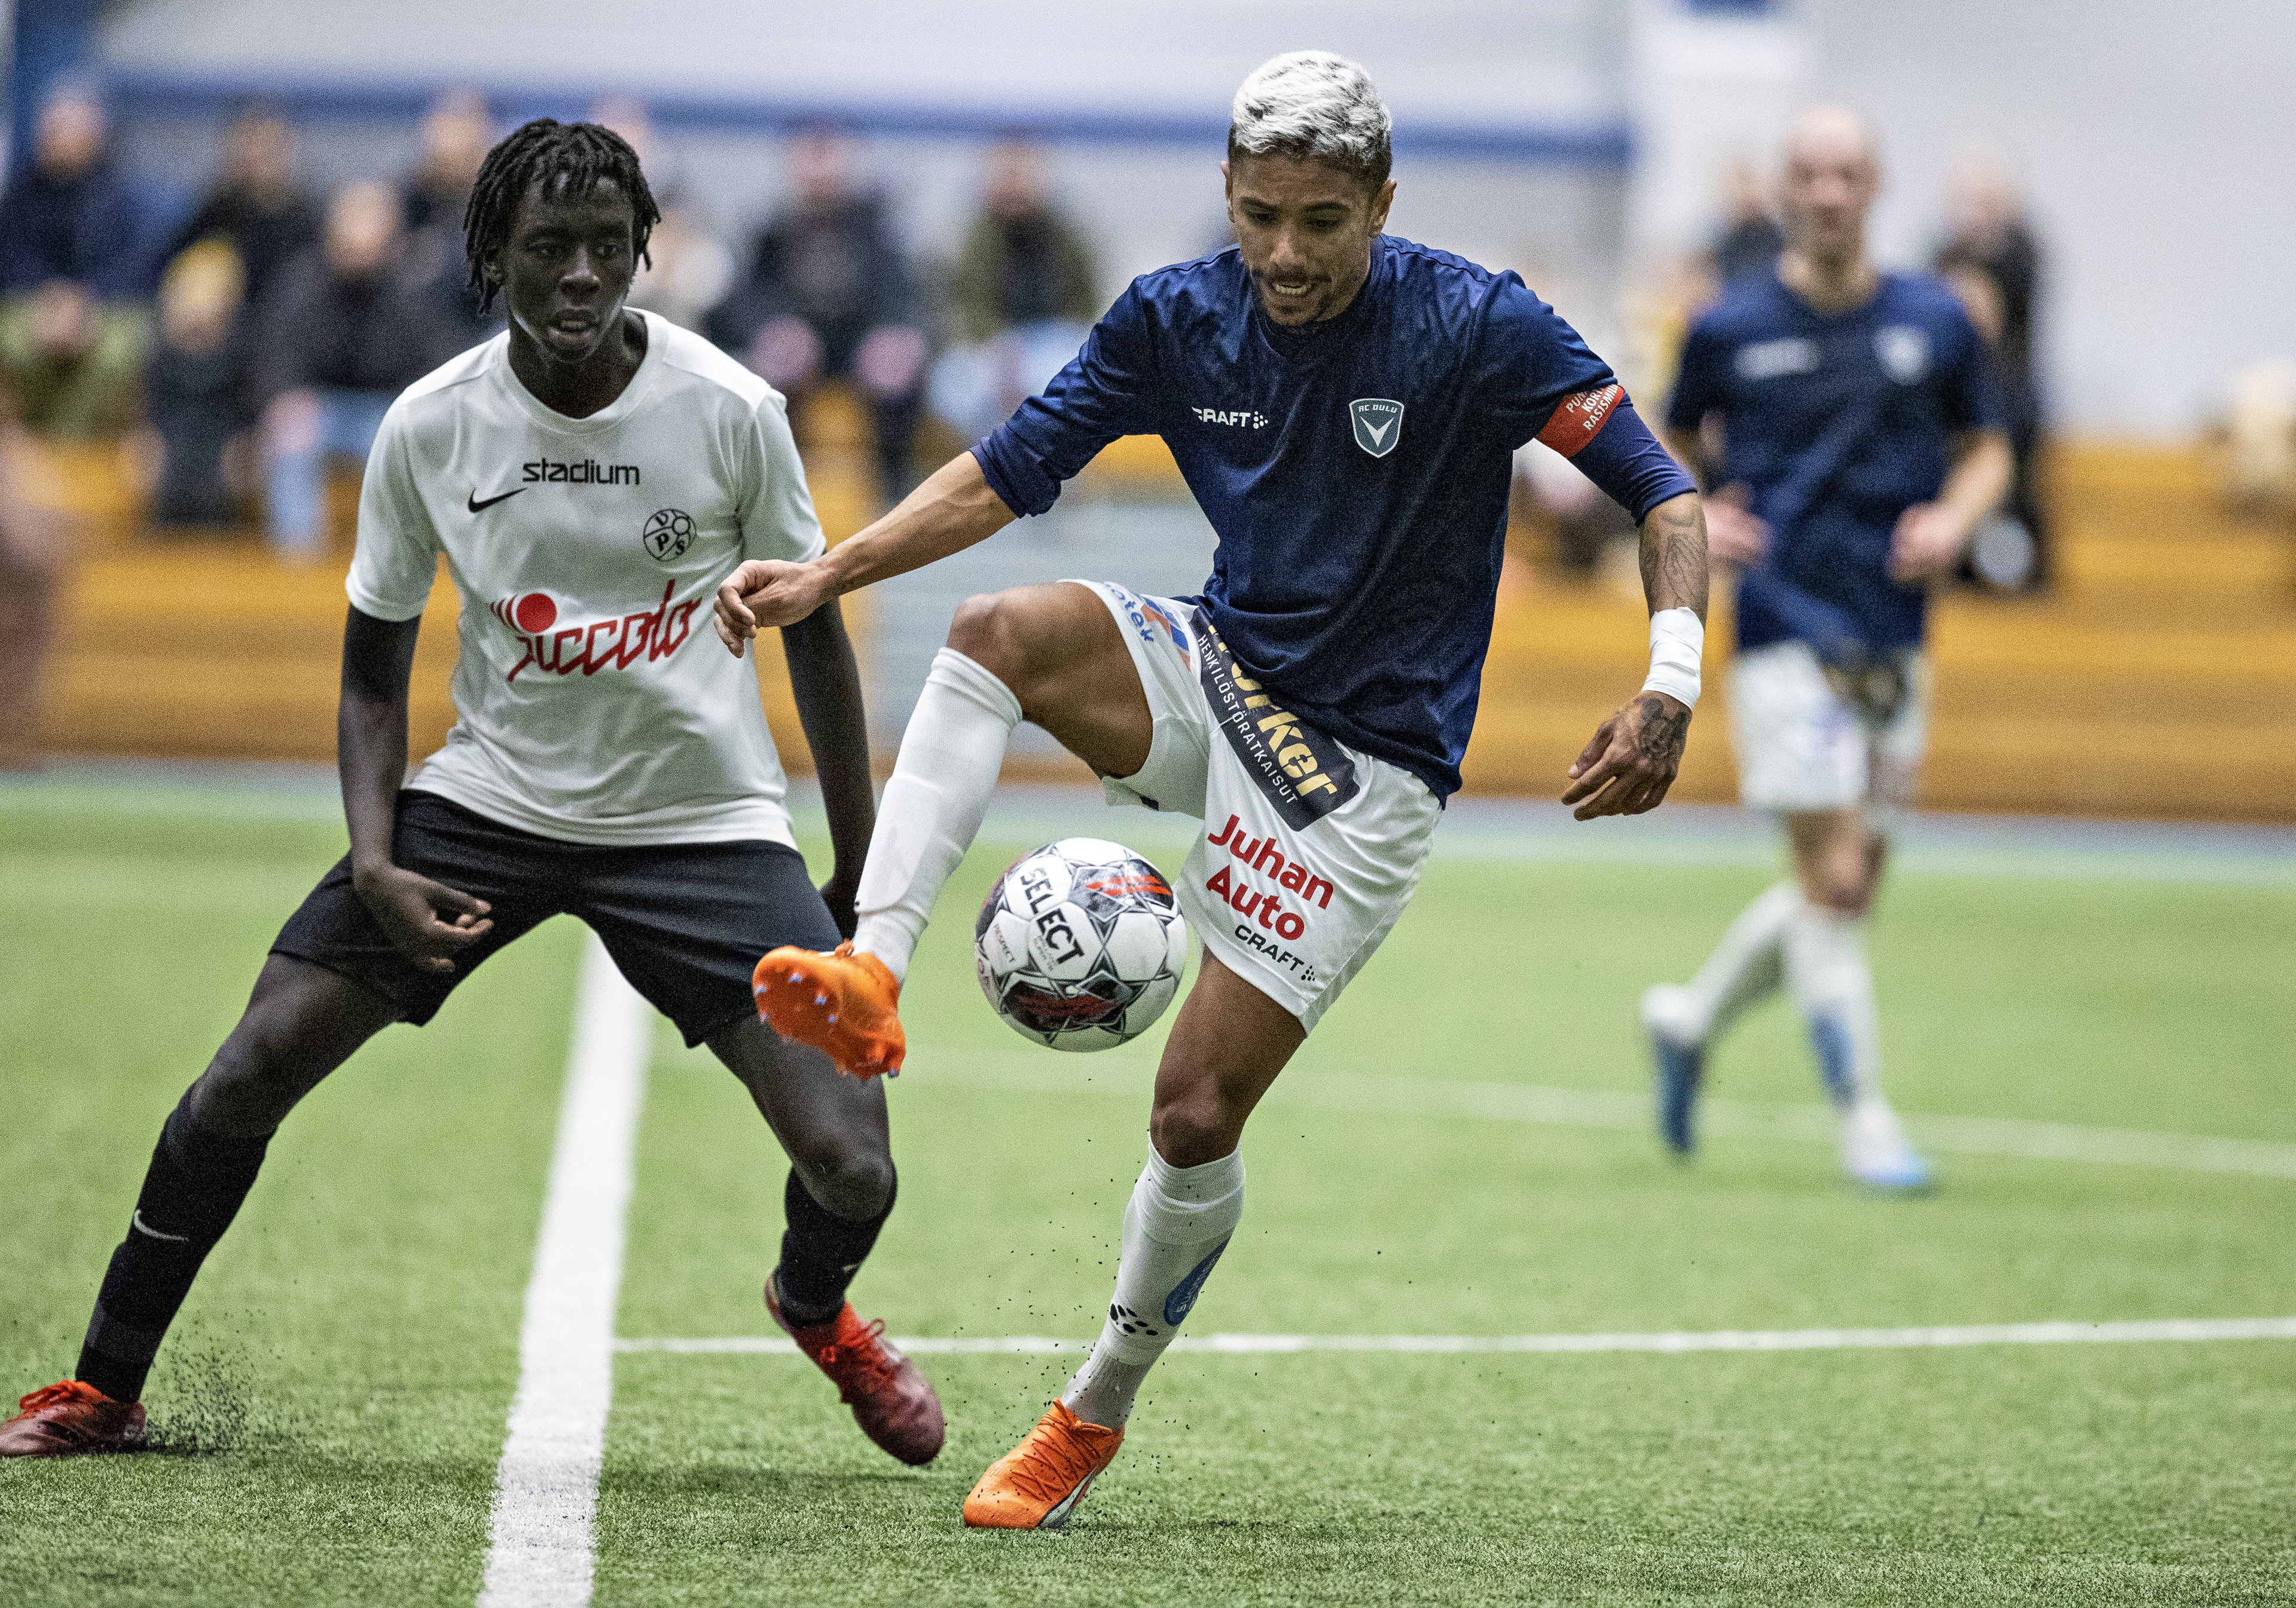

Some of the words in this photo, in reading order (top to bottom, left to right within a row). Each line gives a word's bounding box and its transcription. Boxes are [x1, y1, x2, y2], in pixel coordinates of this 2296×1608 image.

[1372, 404, 1397, 414] OULU
[1565, 392, 1588, 414] PUN
[522, 458, 640, 485] stadium
[1197, 634, 1298, 805] HENKILÖSTÖRATKAISUT
[1207, 814, 1334, 910] Juhan
[1020, 867, 1085, 964] SELECT
[1206, 864, 1305, 941] Auto
[1235, 924, 1305, 971] CRAFT
